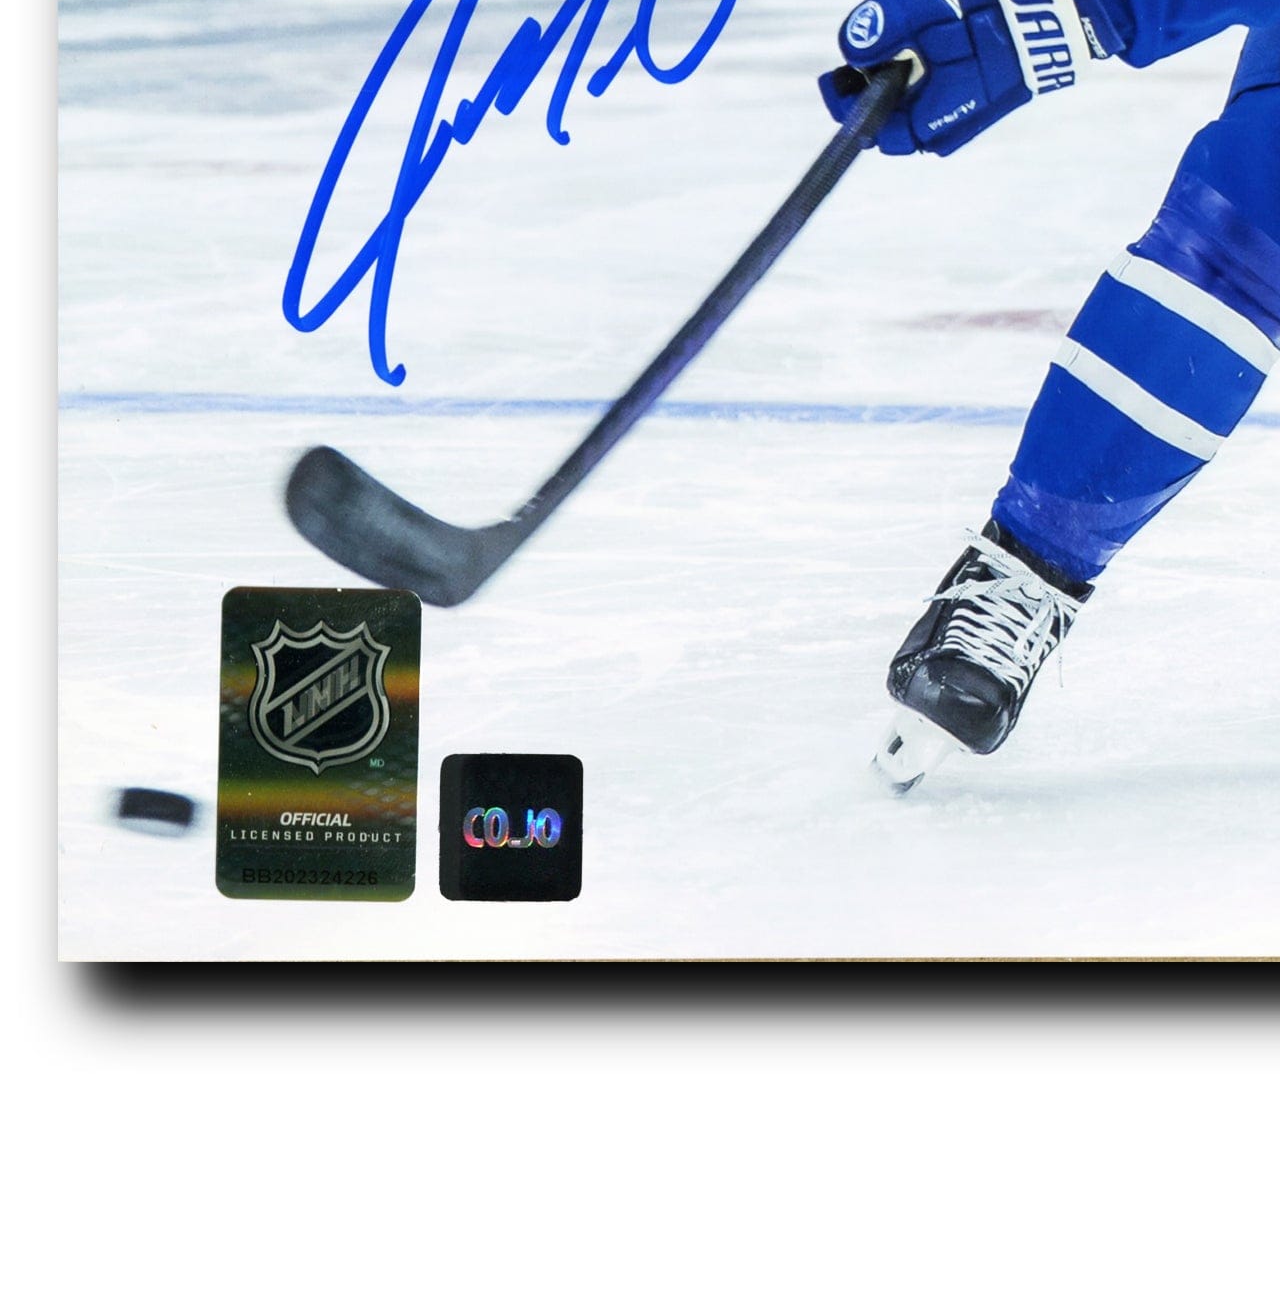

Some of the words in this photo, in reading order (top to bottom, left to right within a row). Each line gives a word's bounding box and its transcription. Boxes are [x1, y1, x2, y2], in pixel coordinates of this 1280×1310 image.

[369, 759, 385, 768] MD
[279, 811, 352, 827] OFFICIAL
[230, 829, 315, 841] LICENSED
[324, 831, 402, 843] PRODUCT
[241, 868, 379, 886] BB202324226
